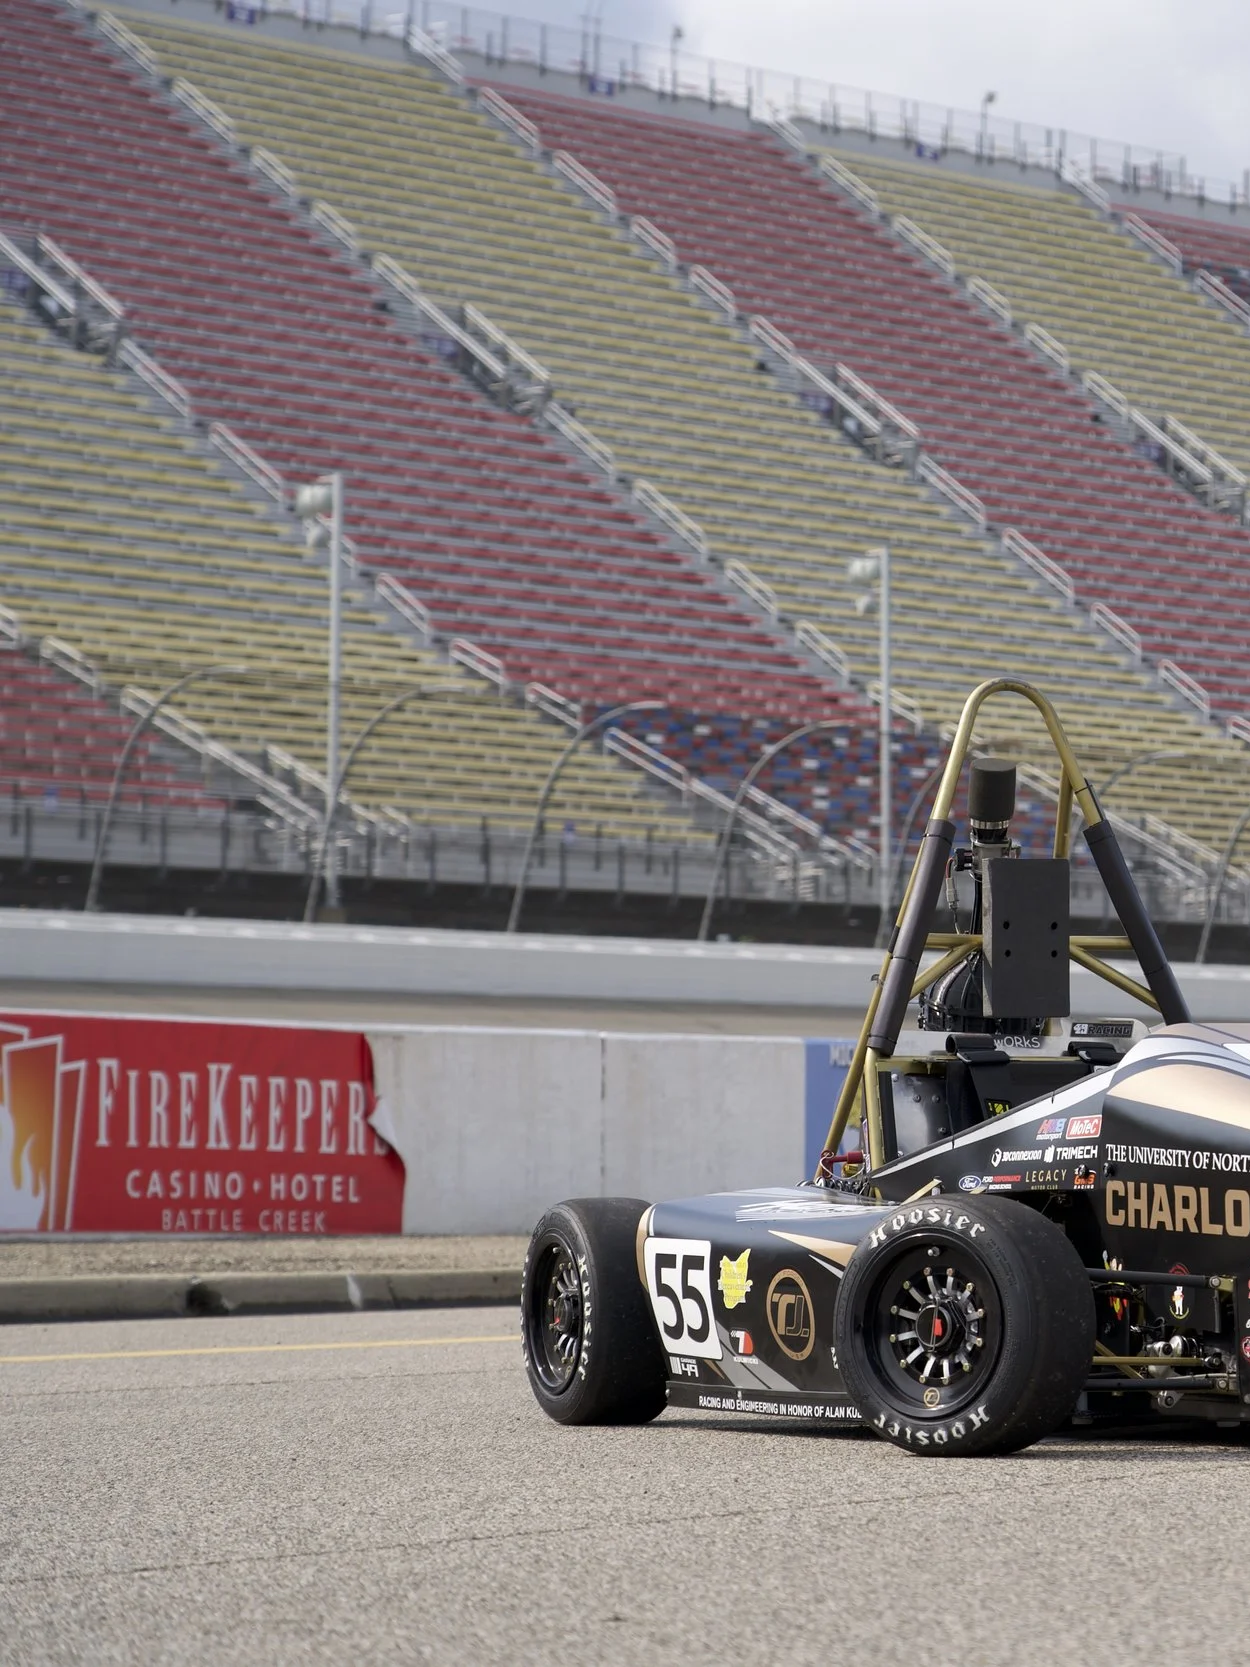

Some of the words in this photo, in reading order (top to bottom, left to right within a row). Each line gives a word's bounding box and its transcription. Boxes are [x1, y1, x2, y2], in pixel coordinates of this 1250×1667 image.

[1056, 1145, 1099, 1161] TRIMECH
[1105, 1144, 1127, 1163] THE
[1128, 1145, 1191, 1169] UNIVERSITY
[1193, 1151, 1211, 1170] OF
[126, 1169, 245, 1200] CASINO
[269, 1173, 362, 1204] HOTEL
[1025, 1168, 1067, 1183] LEGACY
[161, 1208, 244, 1232] BATTLE
[258, 1210, 328, 1233] CREEK
[868, 1206, 986, 1250] Hoosier
[655, 1252, 711, 1344] 55
[681, 1363, 699, 1378] 49
[698, 1395, 721, 1409] RACING
[722, 1398, 736, 1410] AND
[736, 1399, 779, 1415] ENGINEERING
[779, 1403, 787, 1415] IN
[787, 1404, 813, 1417] HONOR
[813, 1405, 824, 1418] OF
[825, 1406, 845, 1418] ALAN
